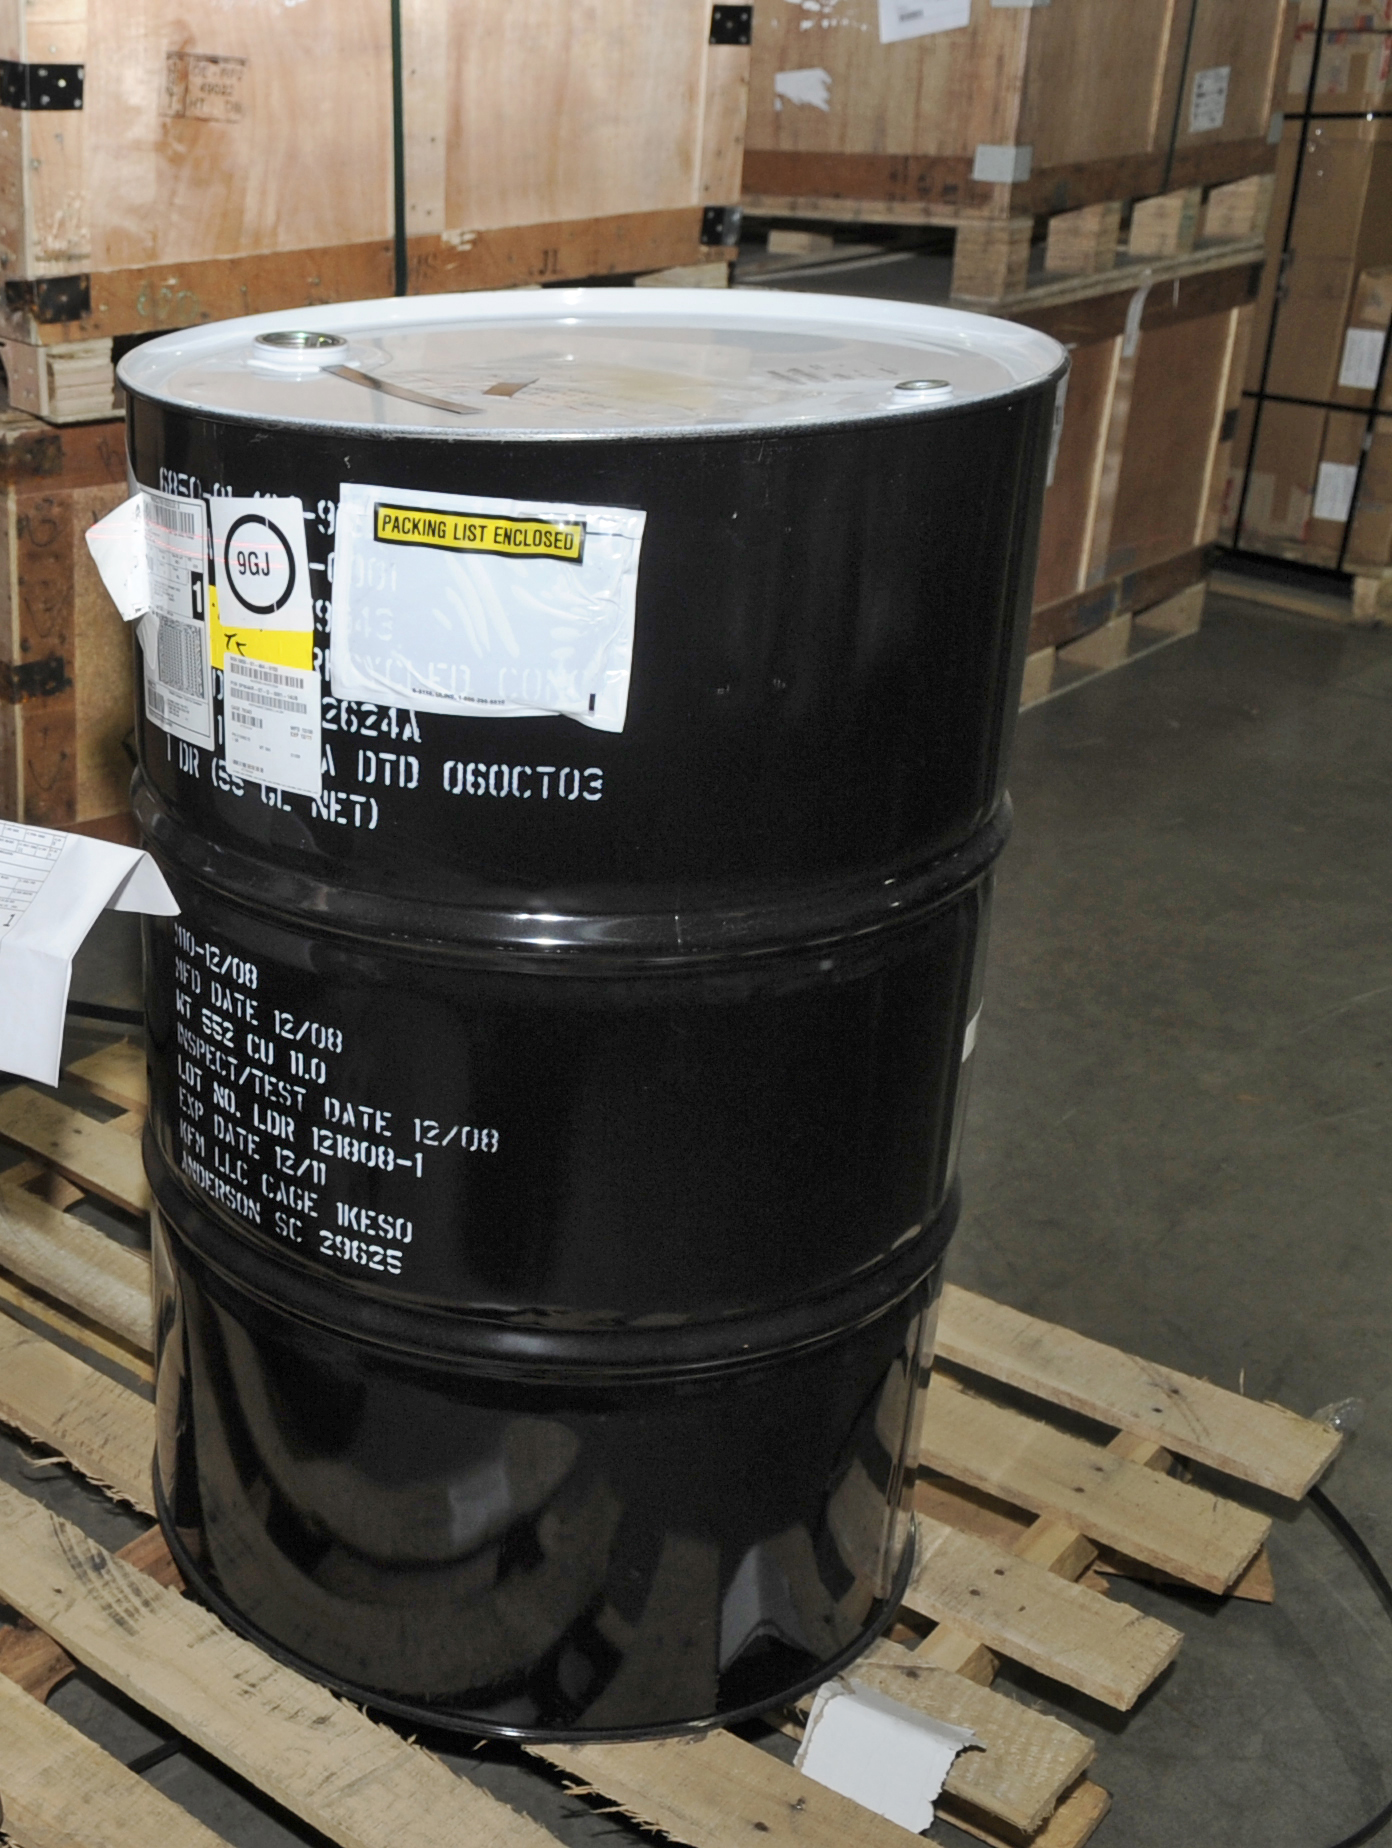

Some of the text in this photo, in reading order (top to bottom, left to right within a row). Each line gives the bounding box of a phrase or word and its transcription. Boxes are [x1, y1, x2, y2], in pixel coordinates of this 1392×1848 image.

[236, 550, 271, 577] 9GJ
[381, 513, 575, 552] PACKING LIST ENCLOSED
[192, 580, 203, 614] 1
[179, 740, 200, 779] DR
[311, 789, 379, 830] NET)
[358, 749, 421, 790] DTD
[442, 760, 605, 801] 06OCT03
[201, 1007, 235, 1049] 552
[246, 1033, 275, 1067] CU
[289, 1049, 327, 1085] 11.0
[211, 980, 259, 1026] DATE
[274, 1009, 344, 1055] 12/08
[176, 1020, 500, 1154] INSPECT/TEST DATE 12/08
[177, 1053, 424, 1179] LOT NO. LDR 121808-1
[178, 1085, 327, 1187] EXP DATE 12/11
[181, 1150, 404, 1276] ANDERSON SC 29625
[214, 1145, 249, 1187] LLC
[261, 1173, 319, 1218] CAGE
